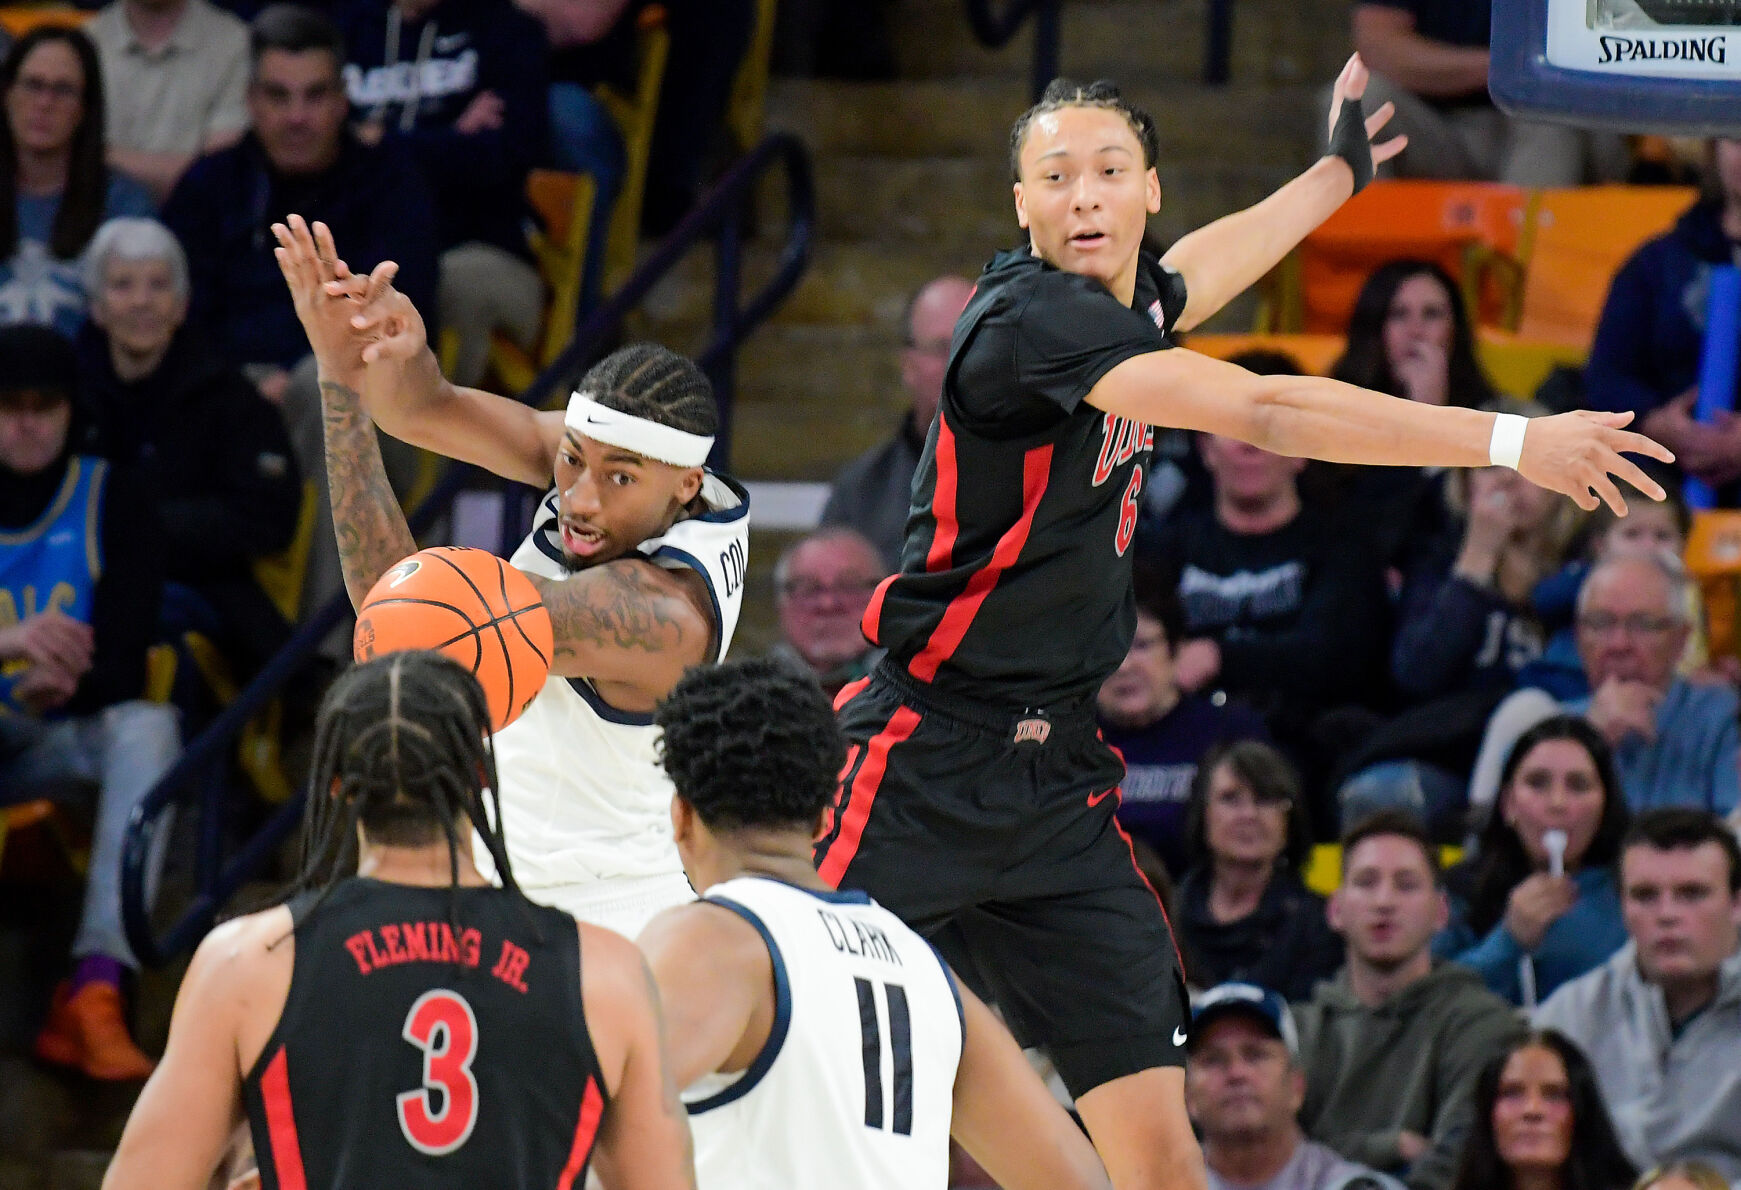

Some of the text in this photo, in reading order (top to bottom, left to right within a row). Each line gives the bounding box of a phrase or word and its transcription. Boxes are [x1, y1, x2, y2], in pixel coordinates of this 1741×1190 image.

[1598, 35, 1726, 64] SPALDING
[1114, 463, 1143, 558] 6
[344, 921, 482, 976] FLEMING
[817, 908, 903, 967] CLARK
[395, 987, 480, 1157] 3
[852, 975, 913, 1137] 11
